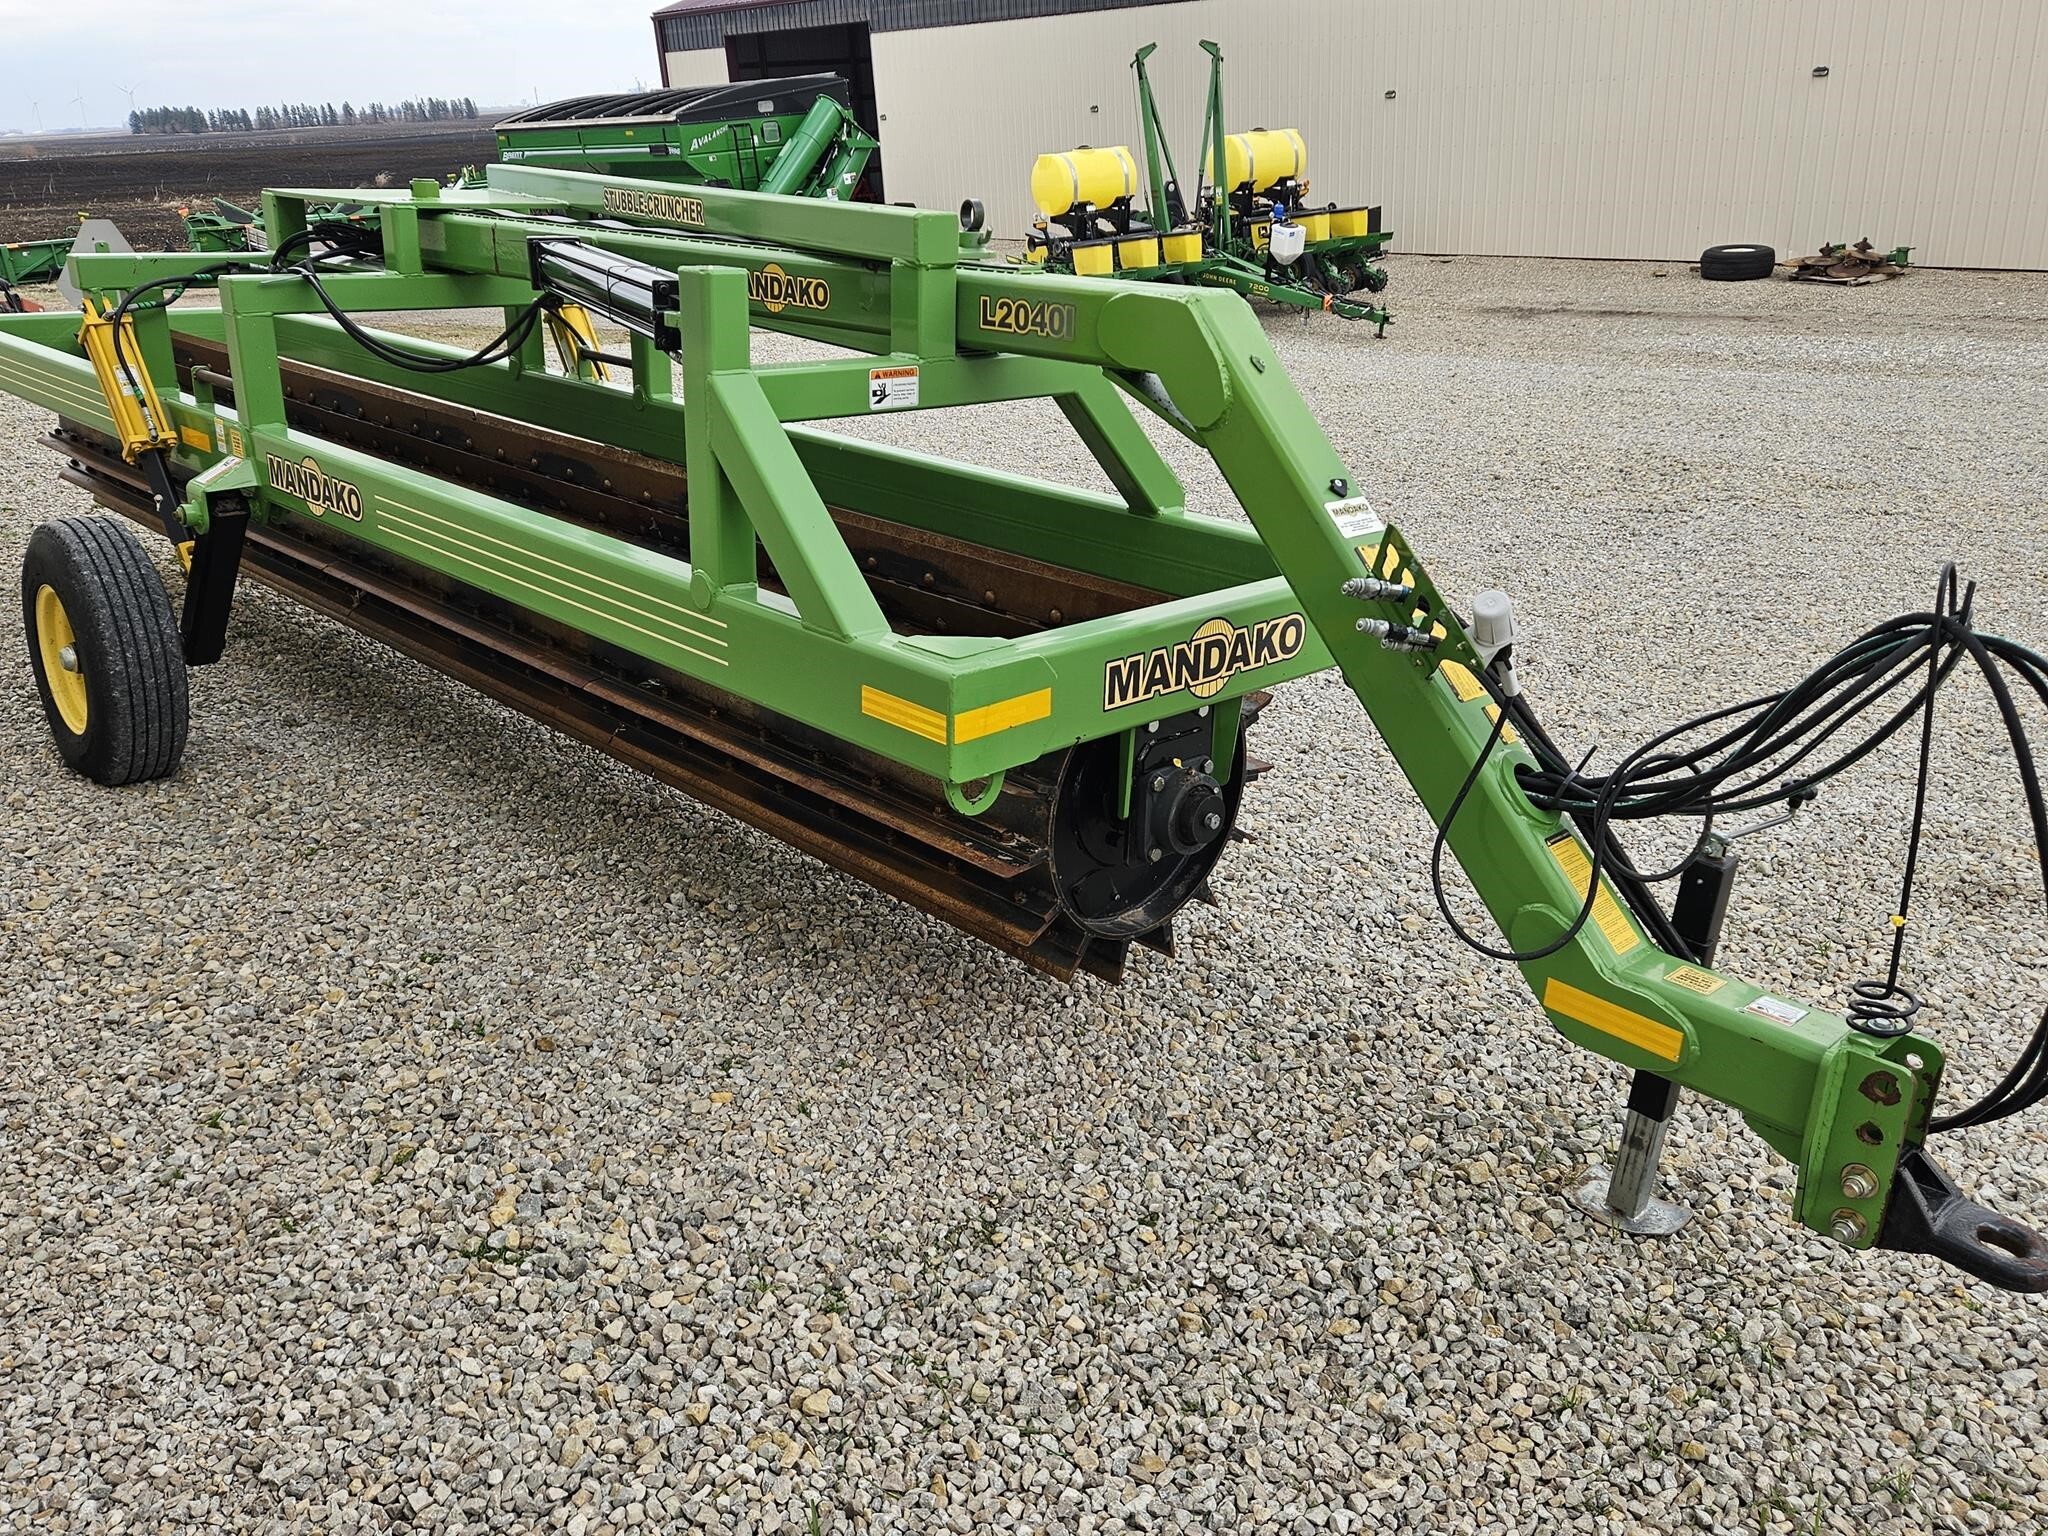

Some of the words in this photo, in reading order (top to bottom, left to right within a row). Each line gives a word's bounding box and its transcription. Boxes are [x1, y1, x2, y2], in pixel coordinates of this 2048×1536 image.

[1203, 273, 1217, 281] JOHN
[1219, 275, 1237, 285] DEERE
[748, 270, 830, 310] NDAKO
[1248, 282, 1270, 293] 7200
[882, 368, 915, 377] WARNING
[267, 453, 363, 521] MANDAKO
[1332, 503, 1369, 517] MANDAKO
[1104, 613, 1306, 711] MANDAKO
